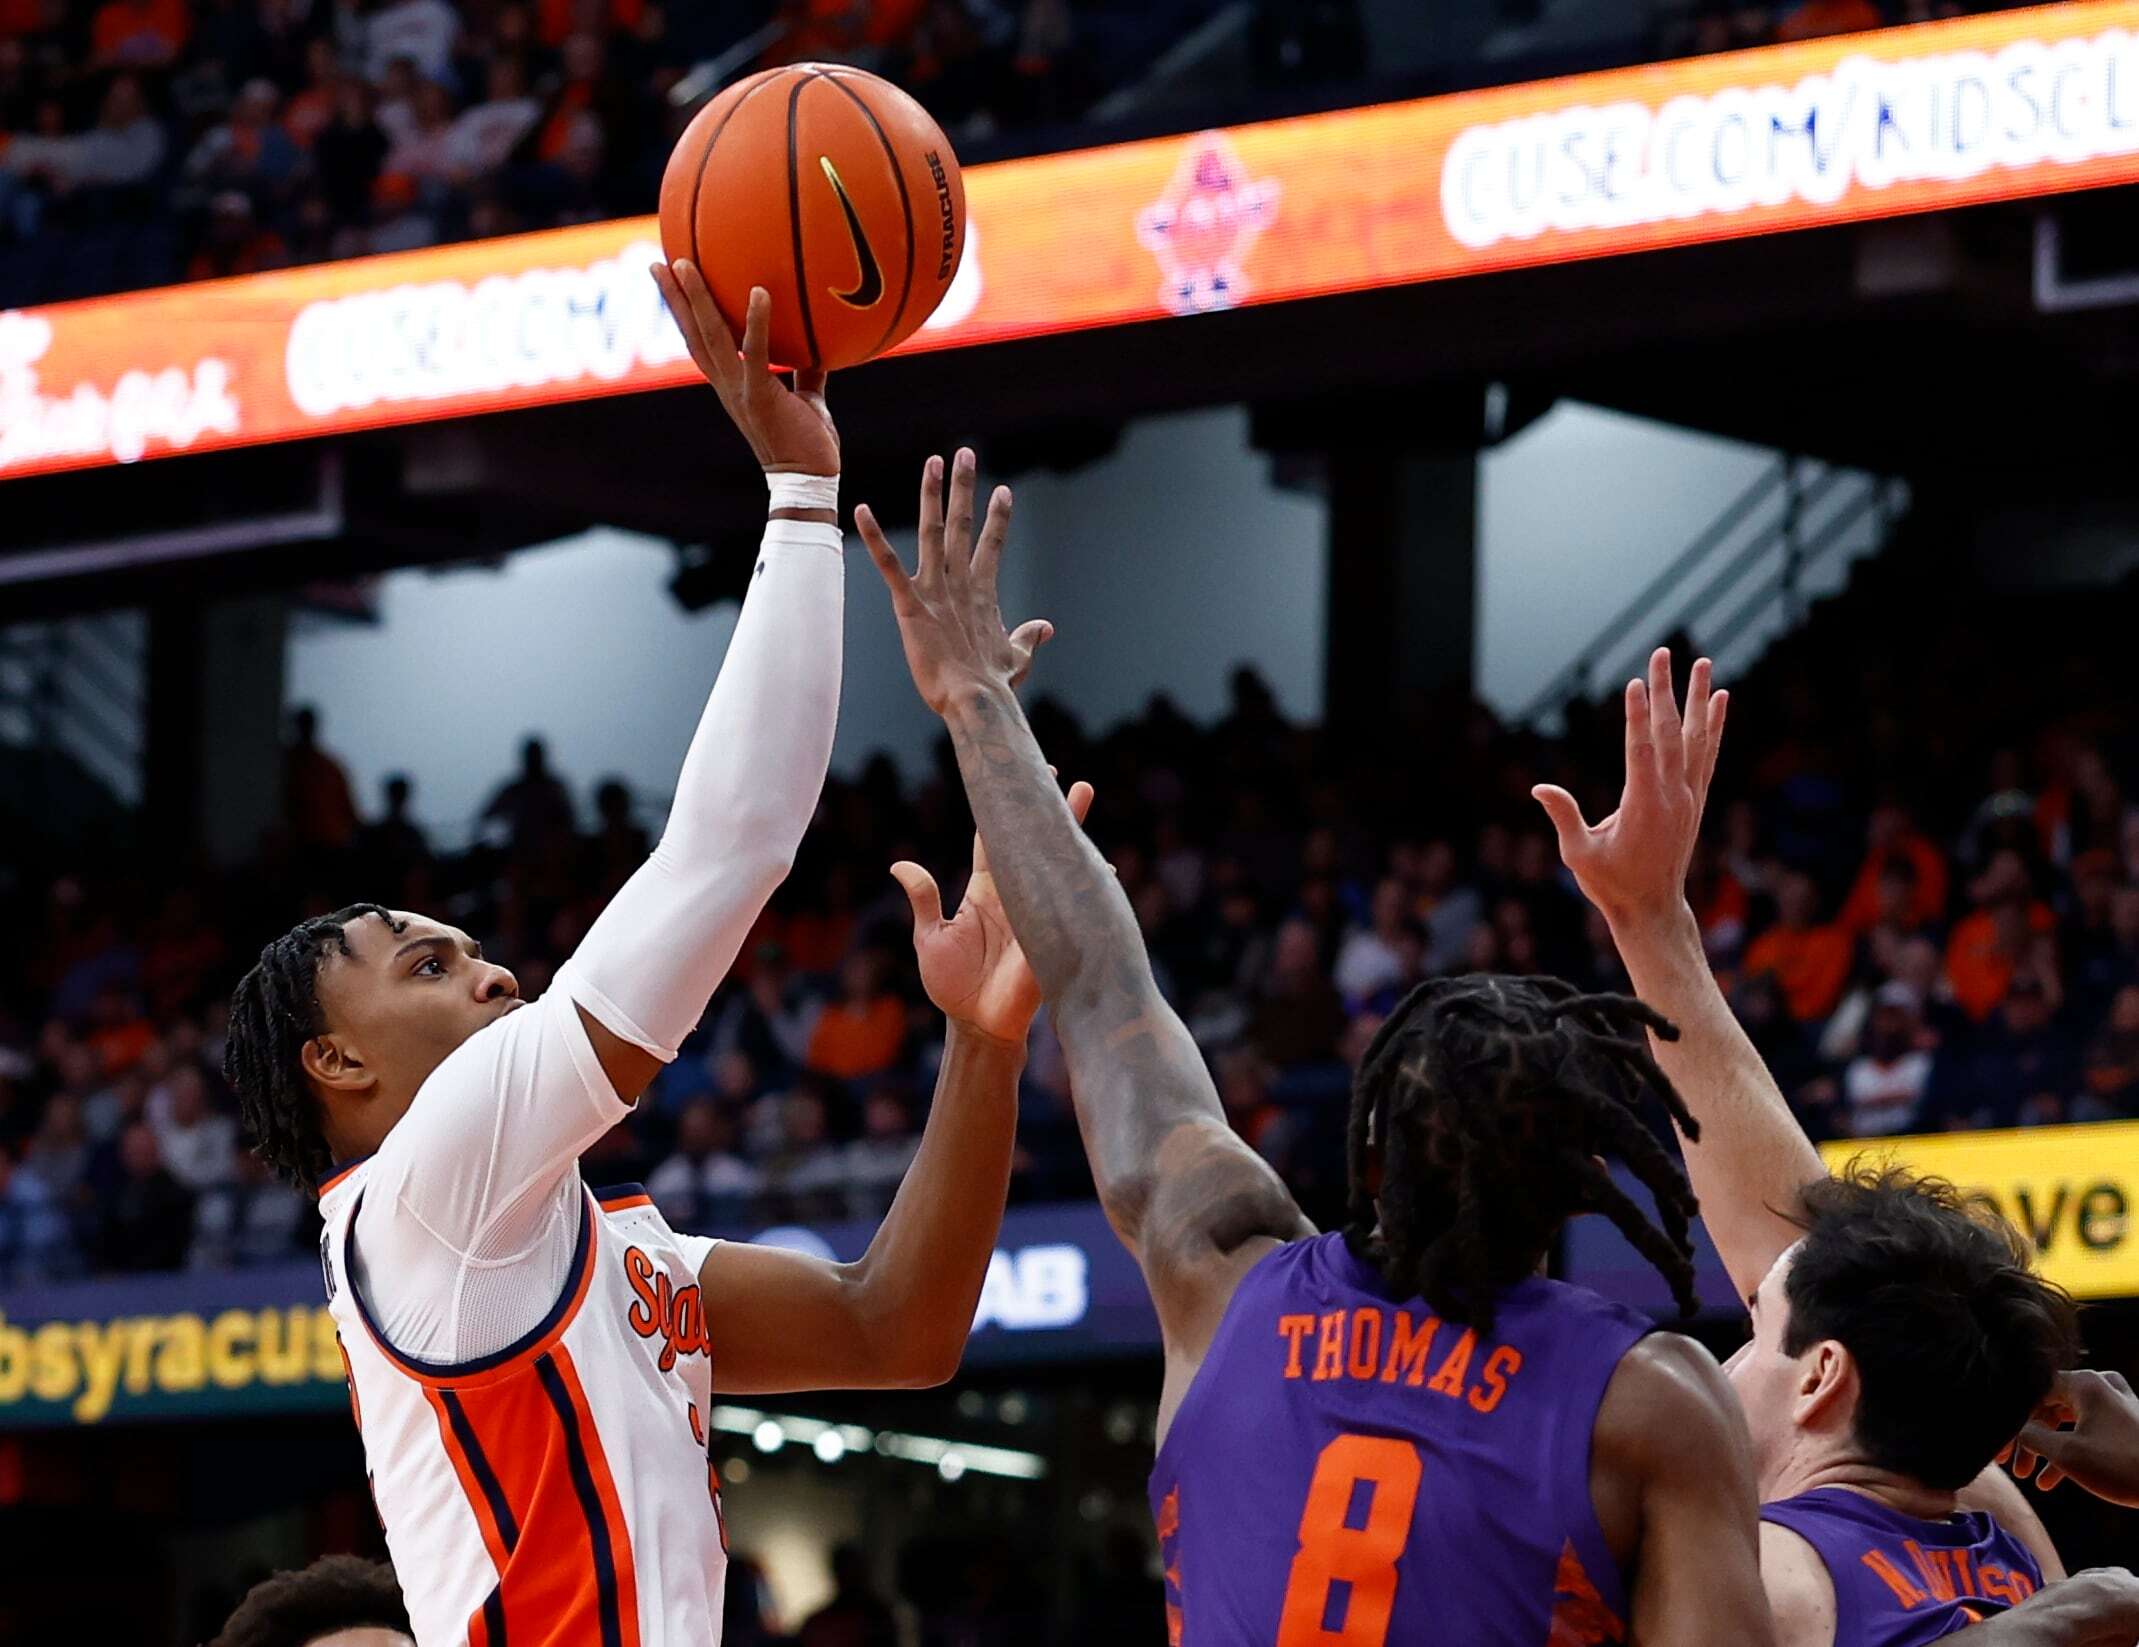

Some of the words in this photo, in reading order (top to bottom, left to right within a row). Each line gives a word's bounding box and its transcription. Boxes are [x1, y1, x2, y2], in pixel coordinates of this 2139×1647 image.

[925, 150, 955, 281] SYRACUSE
[2014, 1179, 2129, 1252] ve
[1278, 1307, 1523, 1413] THOMAS
[1276, 1433, 1423, 1647] 8
